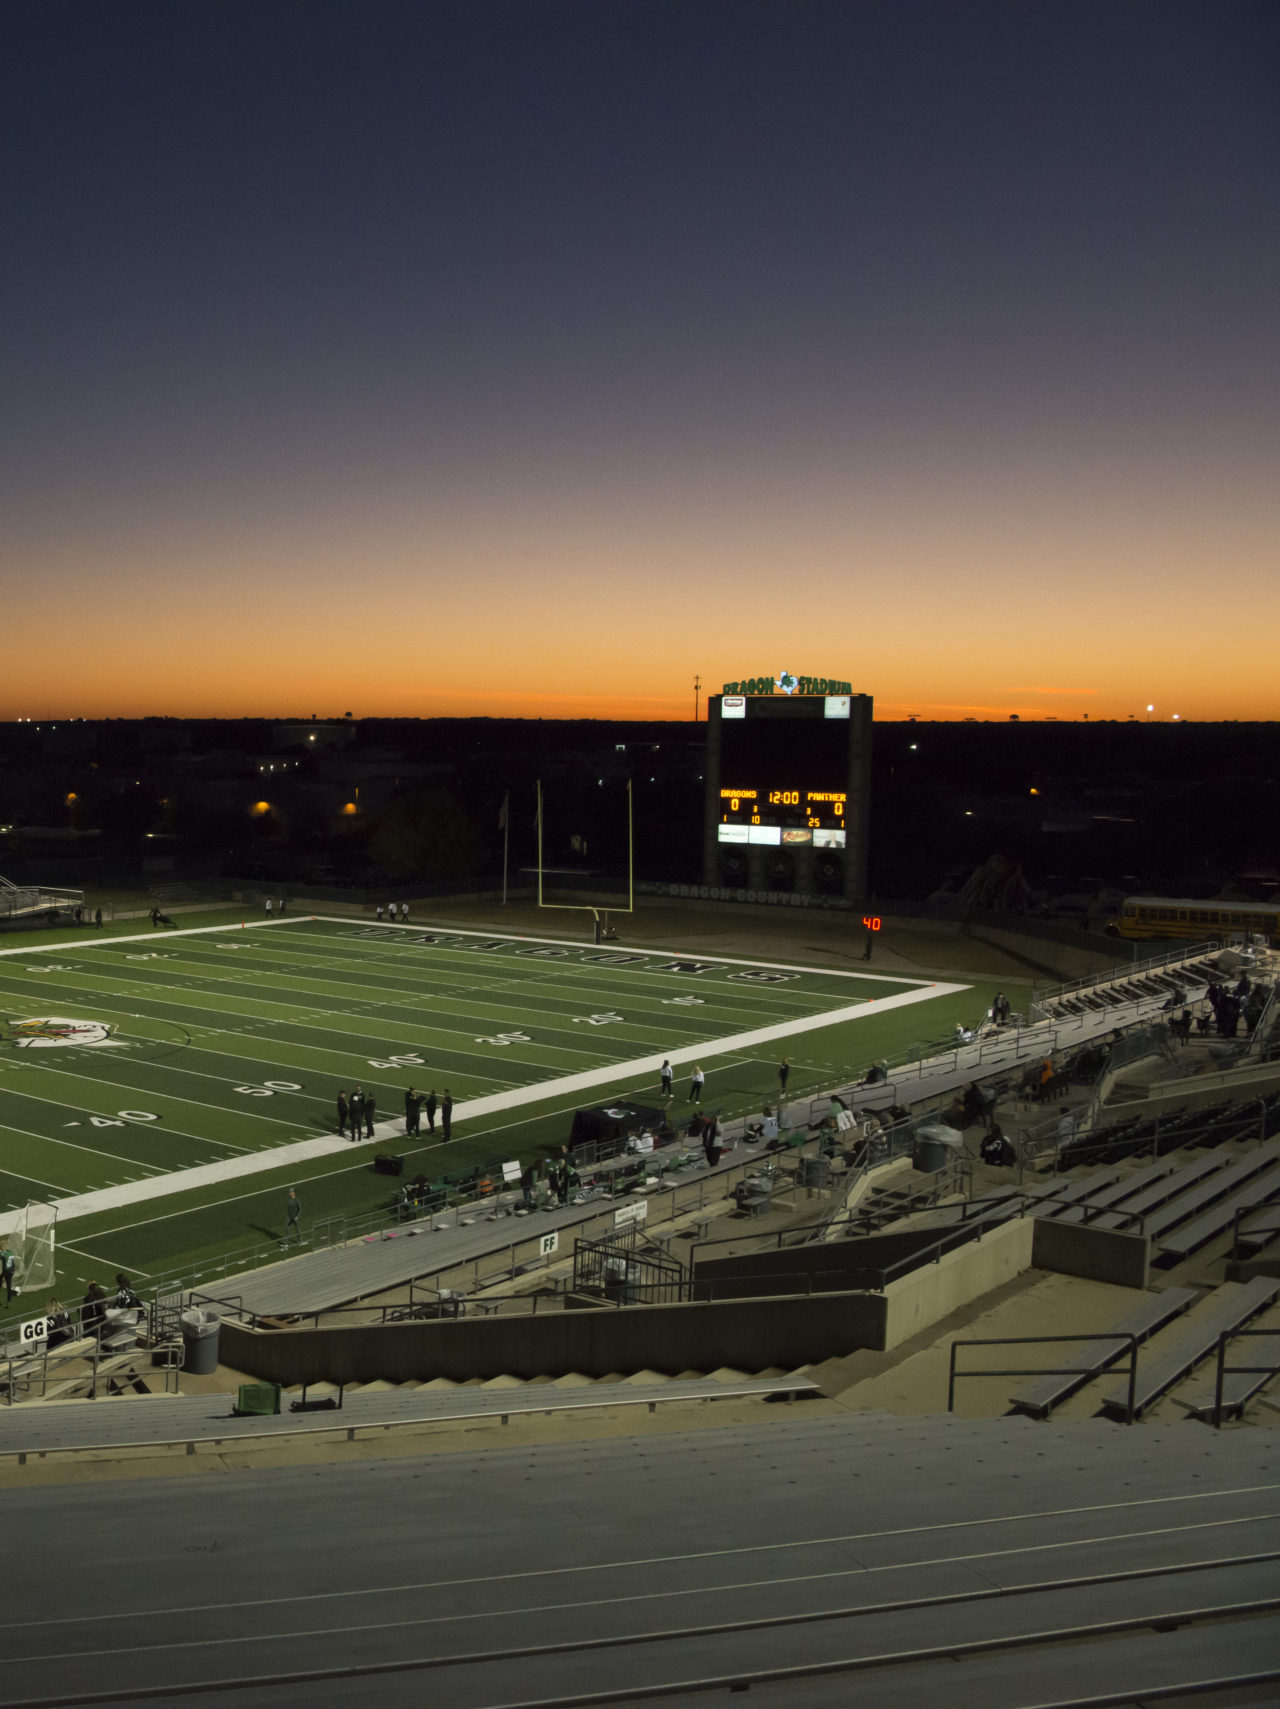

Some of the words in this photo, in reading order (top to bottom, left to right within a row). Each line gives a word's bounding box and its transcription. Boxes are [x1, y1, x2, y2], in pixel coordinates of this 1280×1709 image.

[723, 677, 775, 695] DRAGON
[798, 675, 852, 695] STADIUM
[769, 791, 799, 804] 12:00
[807, 792, 846, 802] PANTHER
[731, 798, 739, 811] 0
[834, 802, 843, 815] 0
[751, 815, 760, 824] 10
[808, 817, 820, 828] 25
[863, 916, 882, 931] 40
[336, 928, 801, 983] DRAGONS
[572, 1014, 624, 1025] 20
[475, 1033, 531, 1046] 30
[367, 1055, 425, 1068] 40
[232, 1080, 302, 1097] 50
[89, 1110, 158, 1128] 40
[543, 1236, 555, 1252] FF
[23, 1321, 44, 1340] GG
